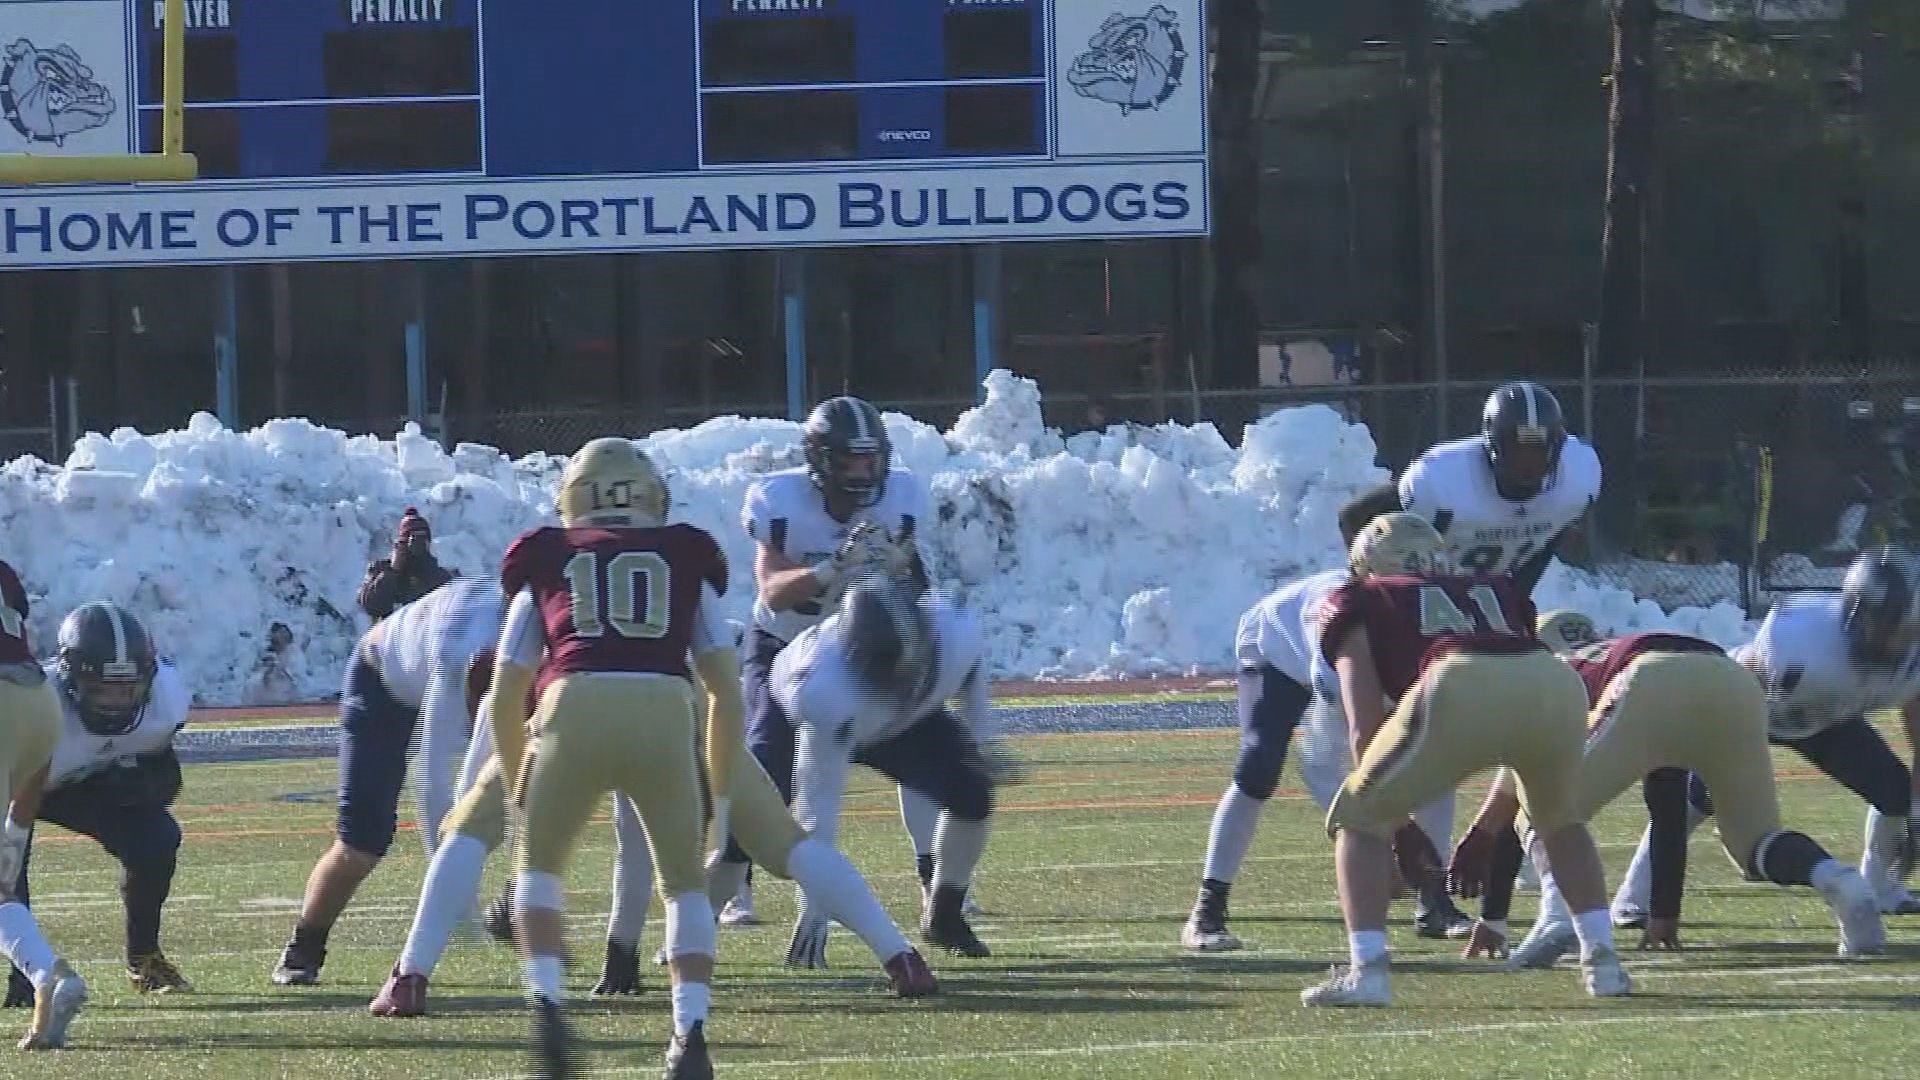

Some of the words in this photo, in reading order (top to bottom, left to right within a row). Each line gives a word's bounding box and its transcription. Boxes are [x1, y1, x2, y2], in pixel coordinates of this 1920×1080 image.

[153, 1, 230, 29] PAYER
[5, 206, 196, 253] HOME
[216, 208, 299, 245] OF
[317, 203, 443, 244] THE
[465, 193, 816, 240] PORTLAND
[839, 181, 1190, 229] BULLDOGS
[563, 551, 671, 638] 10
[1420, 586, 1519, 637] 41
